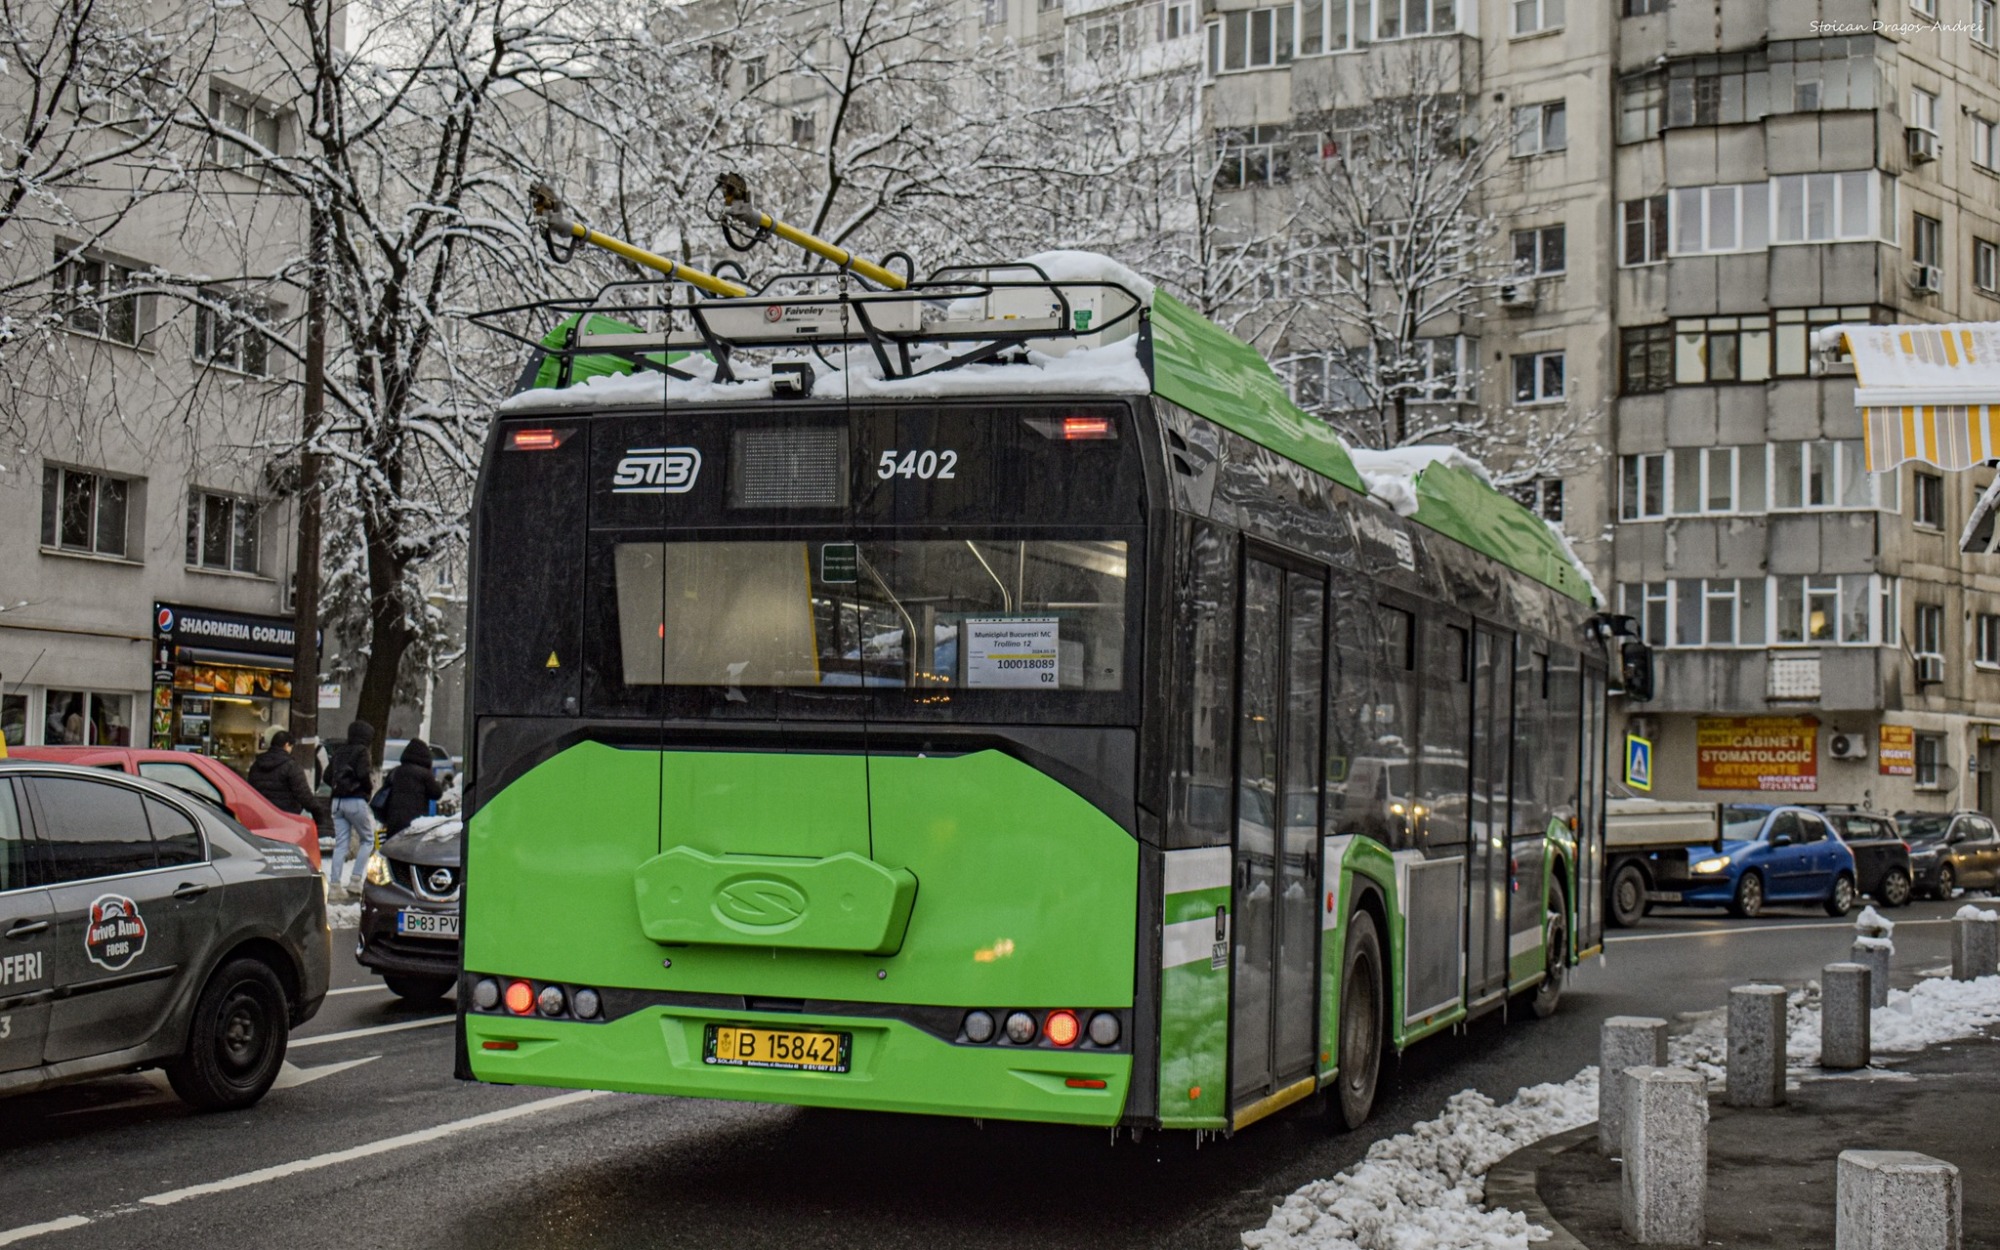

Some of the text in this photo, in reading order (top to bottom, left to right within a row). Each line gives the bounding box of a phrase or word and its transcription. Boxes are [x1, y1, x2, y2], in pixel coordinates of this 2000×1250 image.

[785, 306, 824, 316] Faiveley
[613, 450, 958, 485] STB 5402
[179, 617, 295, 645] SHAORMERIA GORJUL
[997, 659, 1055, 669] 100018089
[1041, 673, 1055, 682] 02
[1733, 736, 1799, 748] CABINET
[1701, 751, 1812, 762] STOMATOLOGIC
[1714, 763, 1799, 775] ORTODONTIE
[1758, 775, 1817, 783] URGENTE
[407, 915, 416, 930] B
[420, 916, 435, 931] 83
[92, 920, 141, 942] Drive Auto
[106, 941, 129, 957] FOCUS
[739, 1033, 835, 1062] B 15842
